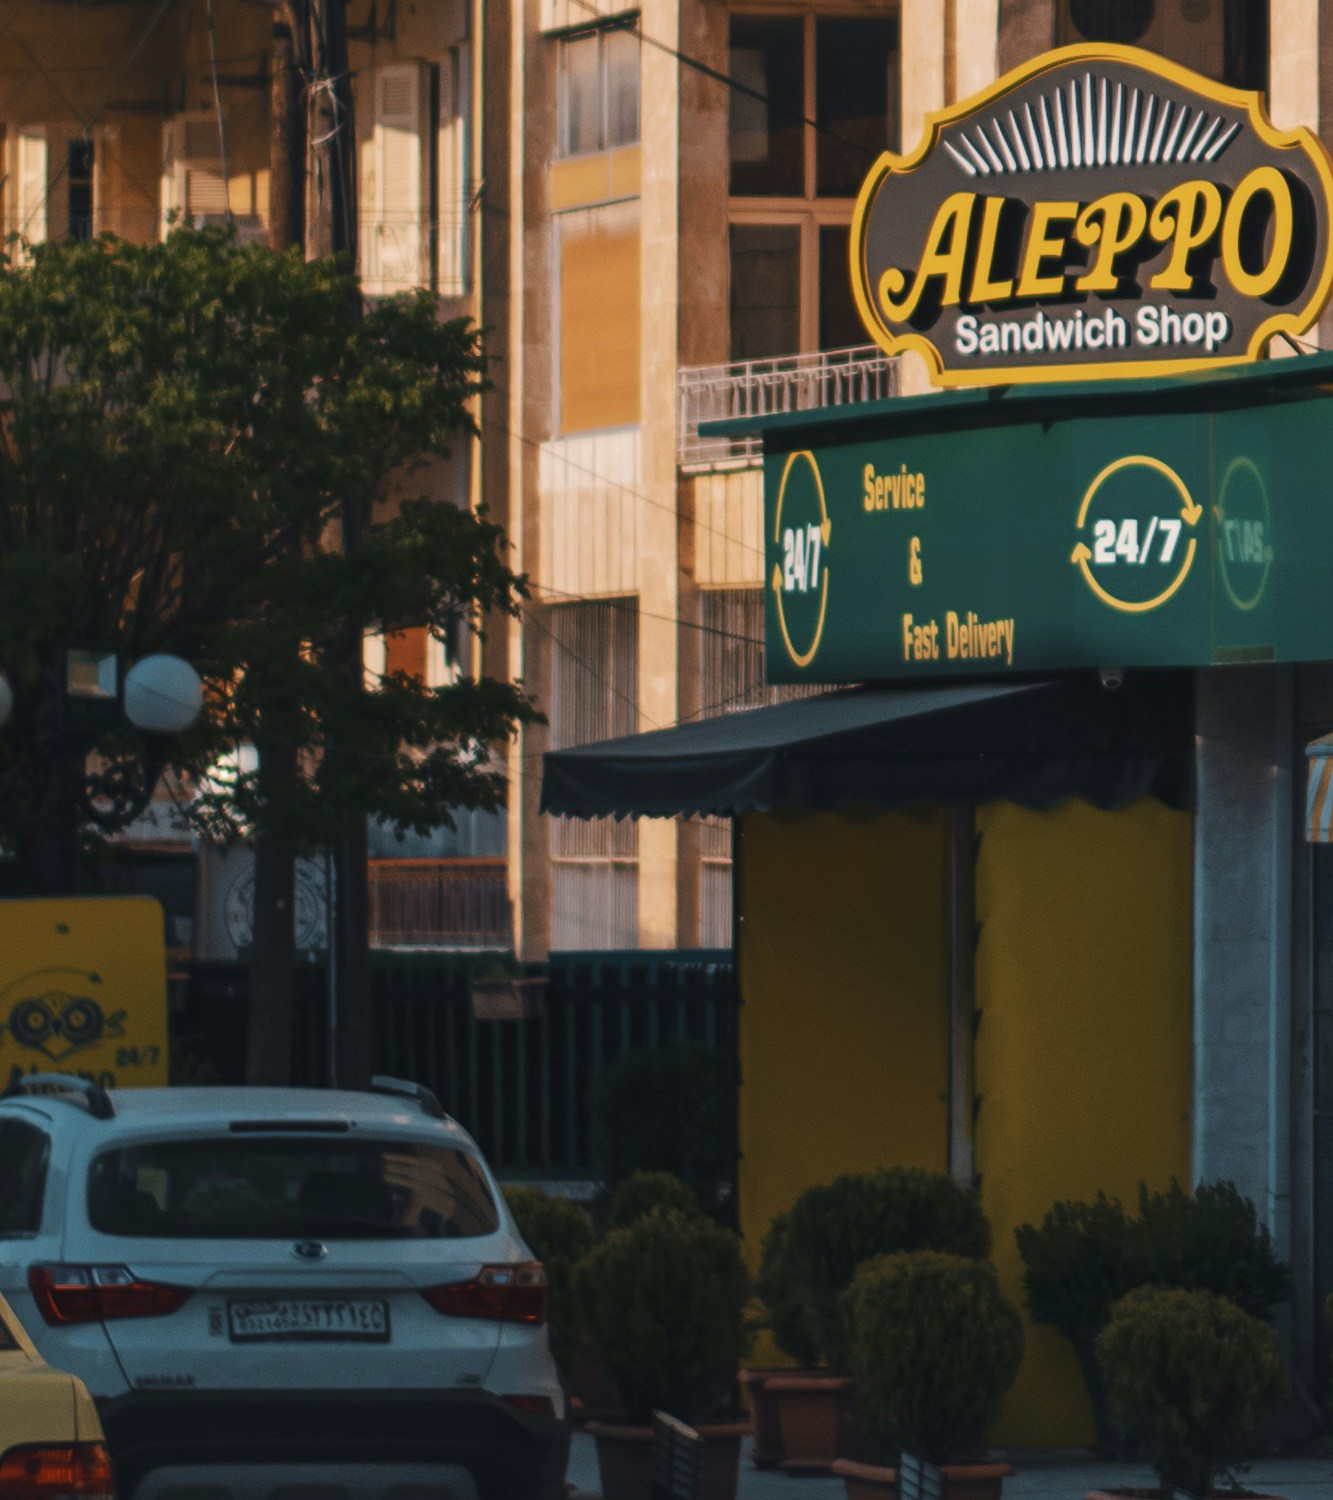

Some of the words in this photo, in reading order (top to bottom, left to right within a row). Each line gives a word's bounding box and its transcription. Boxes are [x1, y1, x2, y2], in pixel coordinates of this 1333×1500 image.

[878, 166, 1294, 322] ALEPPO
[956, 307, 1126, 355] Sandwich
[1136, 303, 1231, 352] Shop
[863, 463, 926, 512] Service
[783, 523, 822, 592] 24/7
[909, 535, 923, 585] &
[1093, 517, 1182, 564] 24/7
[902, 613, 939, 661] Fast
[946, 610, 1015, 666] Delivery
